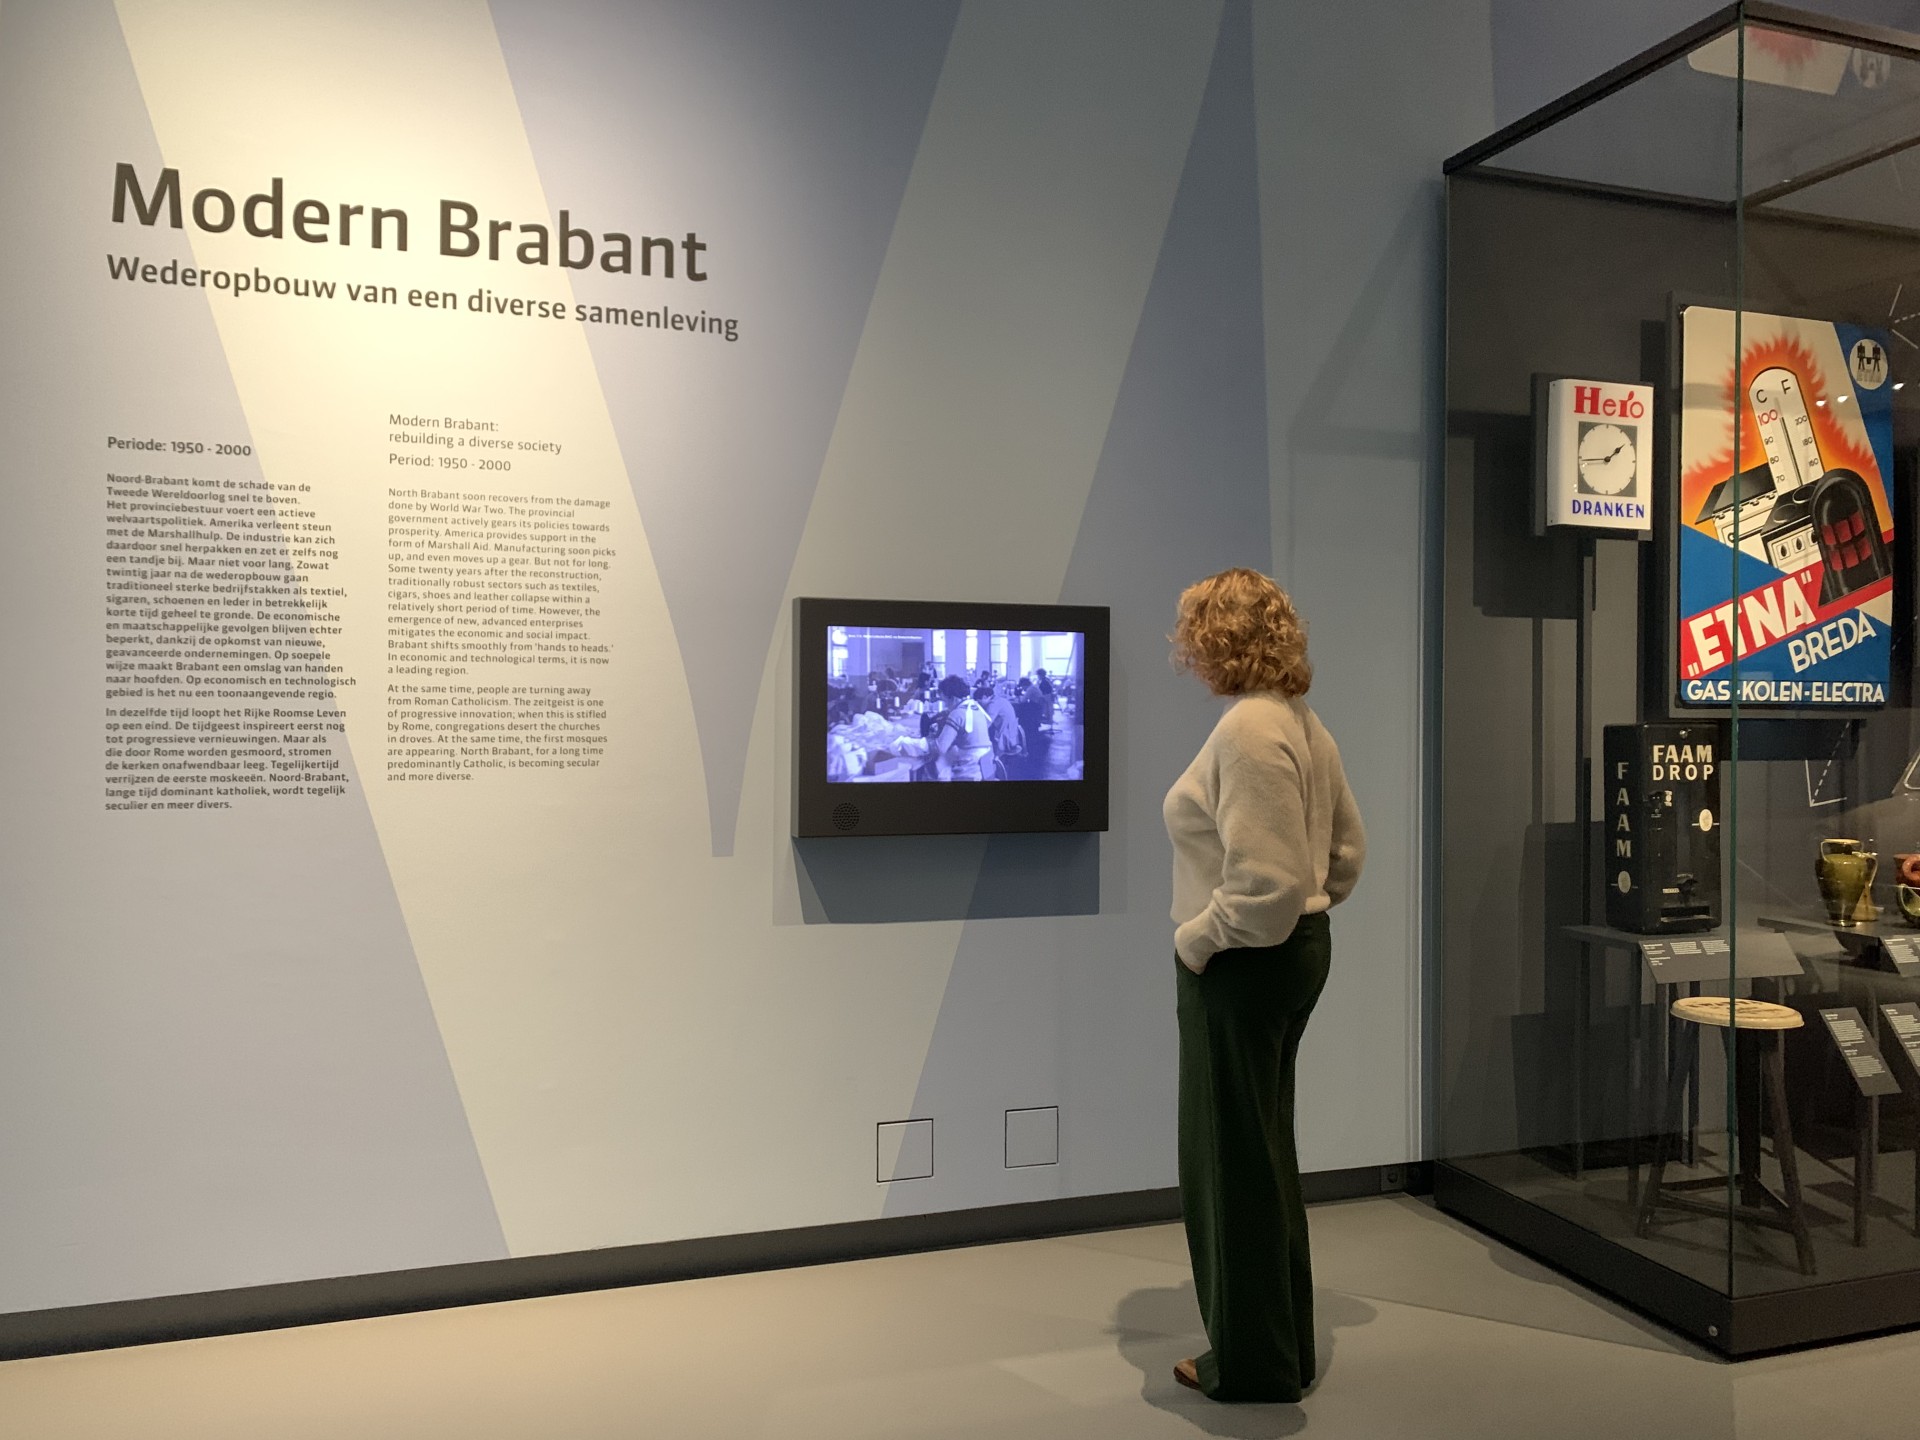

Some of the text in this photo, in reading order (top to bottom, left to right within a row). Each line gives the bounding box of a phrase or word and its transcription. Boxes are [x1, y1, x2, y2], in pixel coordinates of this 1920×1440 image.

[111, 162, 708, 281] Modern Brabant
[107, 254, 739, 341] Wederopbouw van een diverse samenleving
[1781, 379, 1792, 394] F
[1574, 386, 1644, 418] Hero
[1756, 389, 1768, 403] C
[388, 412, 498, 432] Modern Brabant:
[1758, 409, 1777, 426] 100
[107, 435, 166, 451] Periode:
[170, 438, 204, 453] 1950
[215, 440, 251, 456] 2000
[388, 430, 562, 455] rebuilding a diverse society
[388, 452, 434, 467] Period:
[437, 454, 467, 469] 1950
[478, 456, 511, 471] 2000
[106, 472, 311, 492] Noord-Brabant komt de schade van de
[388, 487, 610, 511] North Brabant soon recovers from the damage
[1572, 500, 1644, 518] DRANKEN
[1788, 610, 1877, 674] BREDA
[387, 683, 591, 697] At the same time, people are turning away
[387, 695, 604, 709] from Roman Catholicism. The zeitgeist is one
[105, 707, 346, 720] In dezelfde tijd loopt het Rijke Roomse Leven
[387, 708, 398, 718] of
[400, 708, 457, 721] progressive
[517, 708, 543, 719] when
[545, 708, 564, 719] this
[566, 708, 574, 719] is
[575, 708, 606, 719] stifled
[105, 720, 345, 734] op een eind. De tijdgeest inspireert eerst nog
[387, 720, 600, 734] by Rome, congregations desert the churches
[105, 733, 327, 746] tot progressieve vernieuwingen. Maar als
[387, 733, 396, 743] in
[398, 733, 434, 743] droves.
[437, 733, 448, 743] At
[451, 733, 468, 743] the
[497, 733, 523, 745] time,
[525, 733, 541, 743] the
[543, 733, 564, 743] first
[566, 735, 607, 746] mosques
[104, 745, 331, 759] die door Rome worden gesmoord, stromen
[386, 748, 403, 756] are
[404, 745, 457, 759] appearing.
[460, 745, 489, 756] North
[491, 745, 533, 757] Brabant,
[535, 745, 549, 755] for
[559, 745, 580, 758] long
[582, 744, 603, 755] time
[1653, 745, 1713, 763] FAAM
[104, 759, 339, 772] de kerken onafwendbaar leeg. Tegelijkertijd
[387, 757, 599, 771] predominantly Catholic, is becoming secular
[104, 772, 154, 786] verrijzen
[156, 772, 170, 783] de
[172, 772, 207, 783] eerste
[268, 771, 349, 784] Noord-Brabant,
[386, 770, 474, 781] and more diverse.
[1653, 764, 1714, 781] DROP
[105, 784, 345, 799] lange tijd dominant katholiek, wordt tegelijk
[104, 799, 232, 810] seculier en meer divers.
[1616, 762, 1632, 858] FAAM
